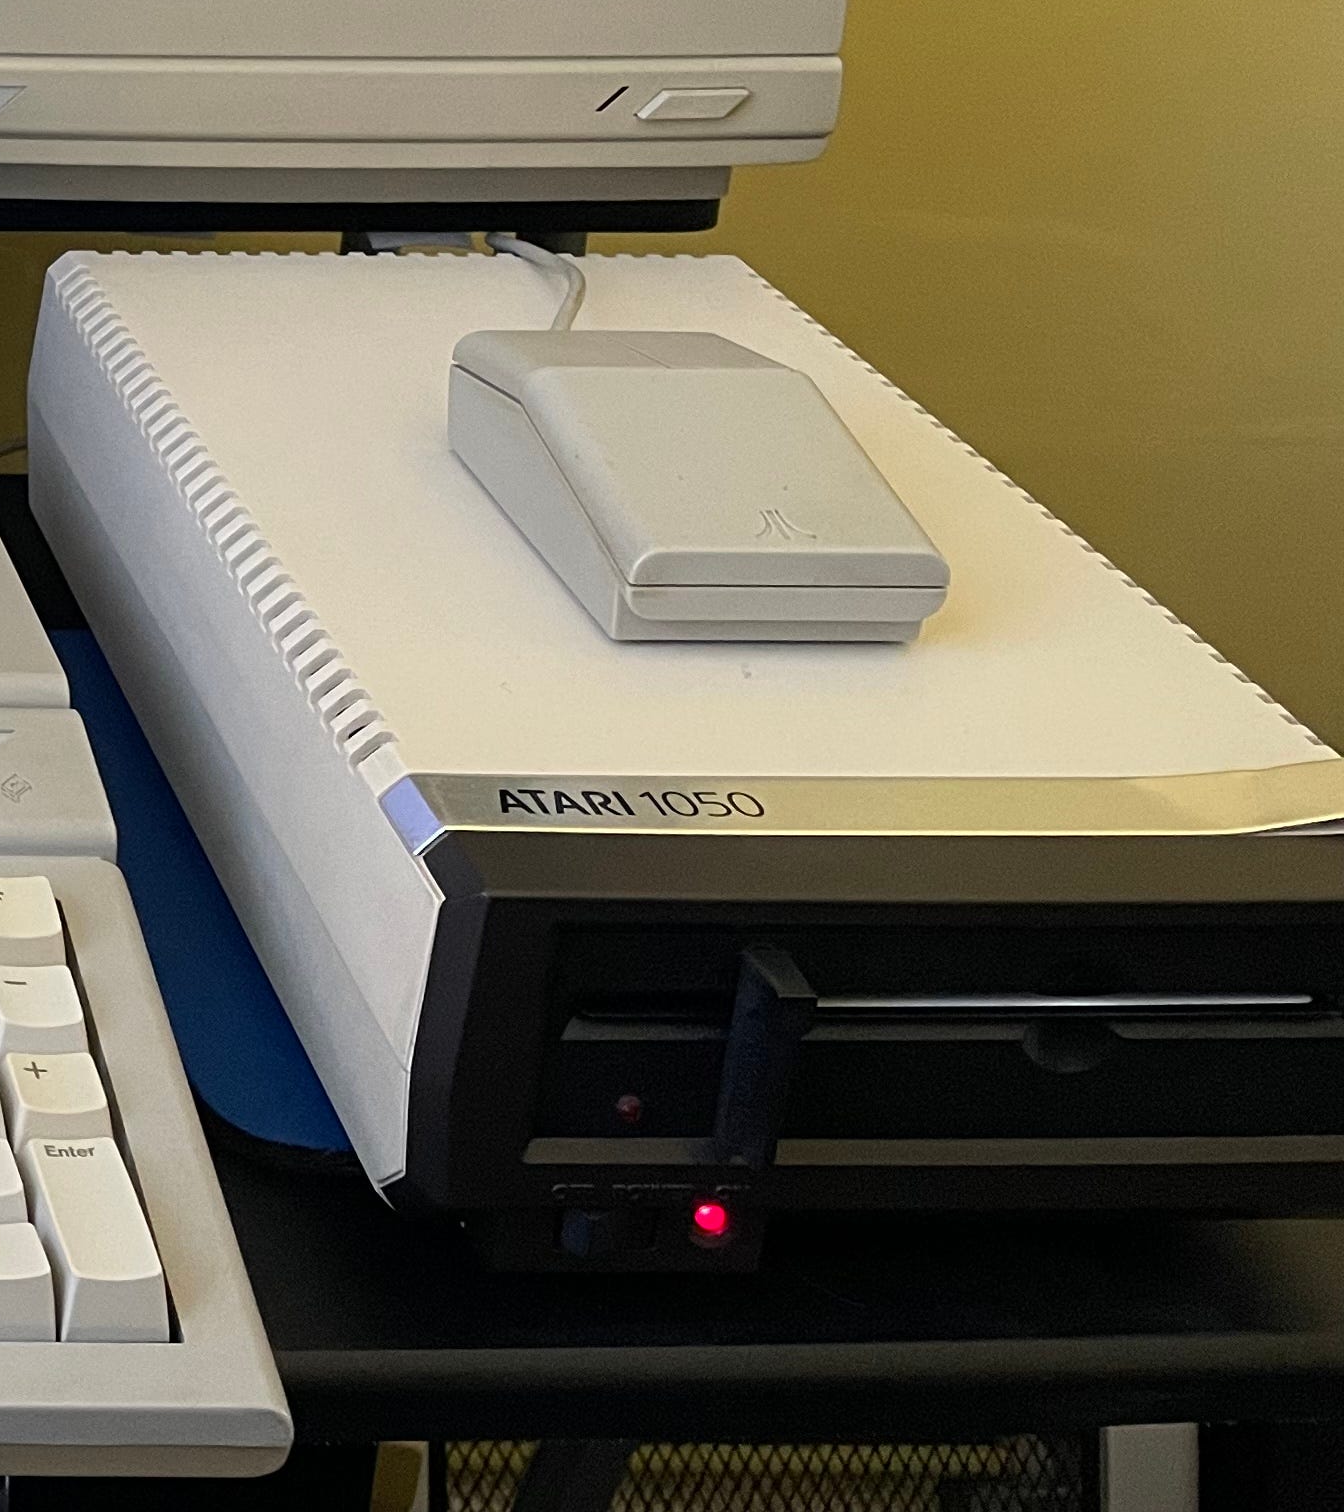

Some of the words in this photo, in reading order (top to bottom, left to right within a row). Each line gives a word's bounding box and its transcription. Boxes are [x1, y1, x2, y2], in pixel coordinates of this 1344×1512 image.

[498, 788, 635, 817] ATARI
[638, 790, 765, 818] 1050
[43, 1143, 96, 1159] Enter
